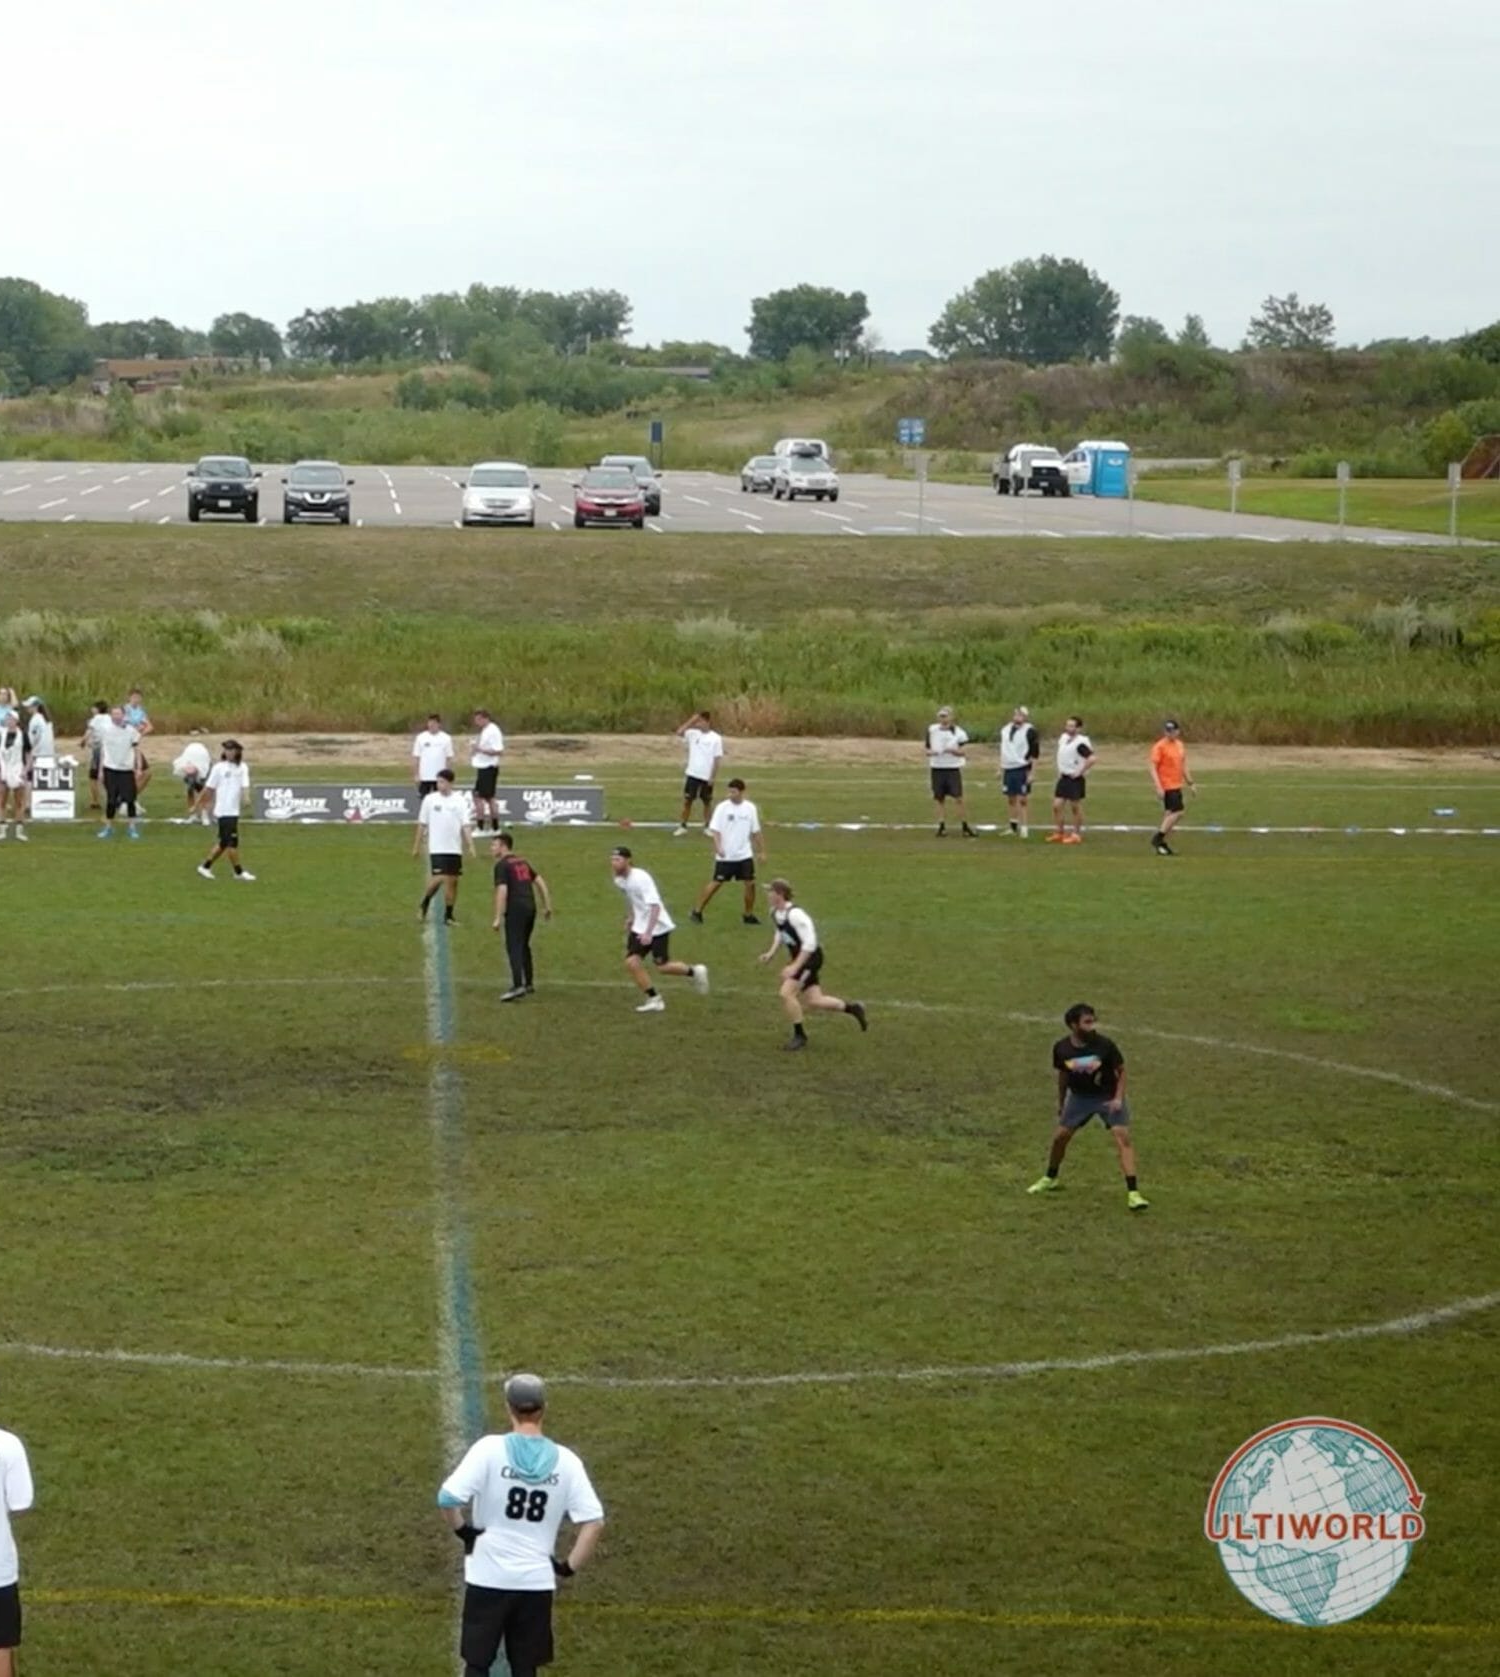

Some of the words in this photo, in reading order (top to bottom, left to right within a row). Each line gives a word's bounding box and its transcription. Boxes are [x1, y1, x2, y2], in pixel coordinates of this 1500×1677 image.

[263, 788, 293, 799] USA
[342, 788, 372, 799] USA
[523, 790, 553, 801] USA
[269, 798, 328, 808] ULTIMATE
[348, 798, 406, 808] ULTIMATE
[529, 800, 588, 810] ULTIMATE
[505, 1486, 549, 1522] 88
